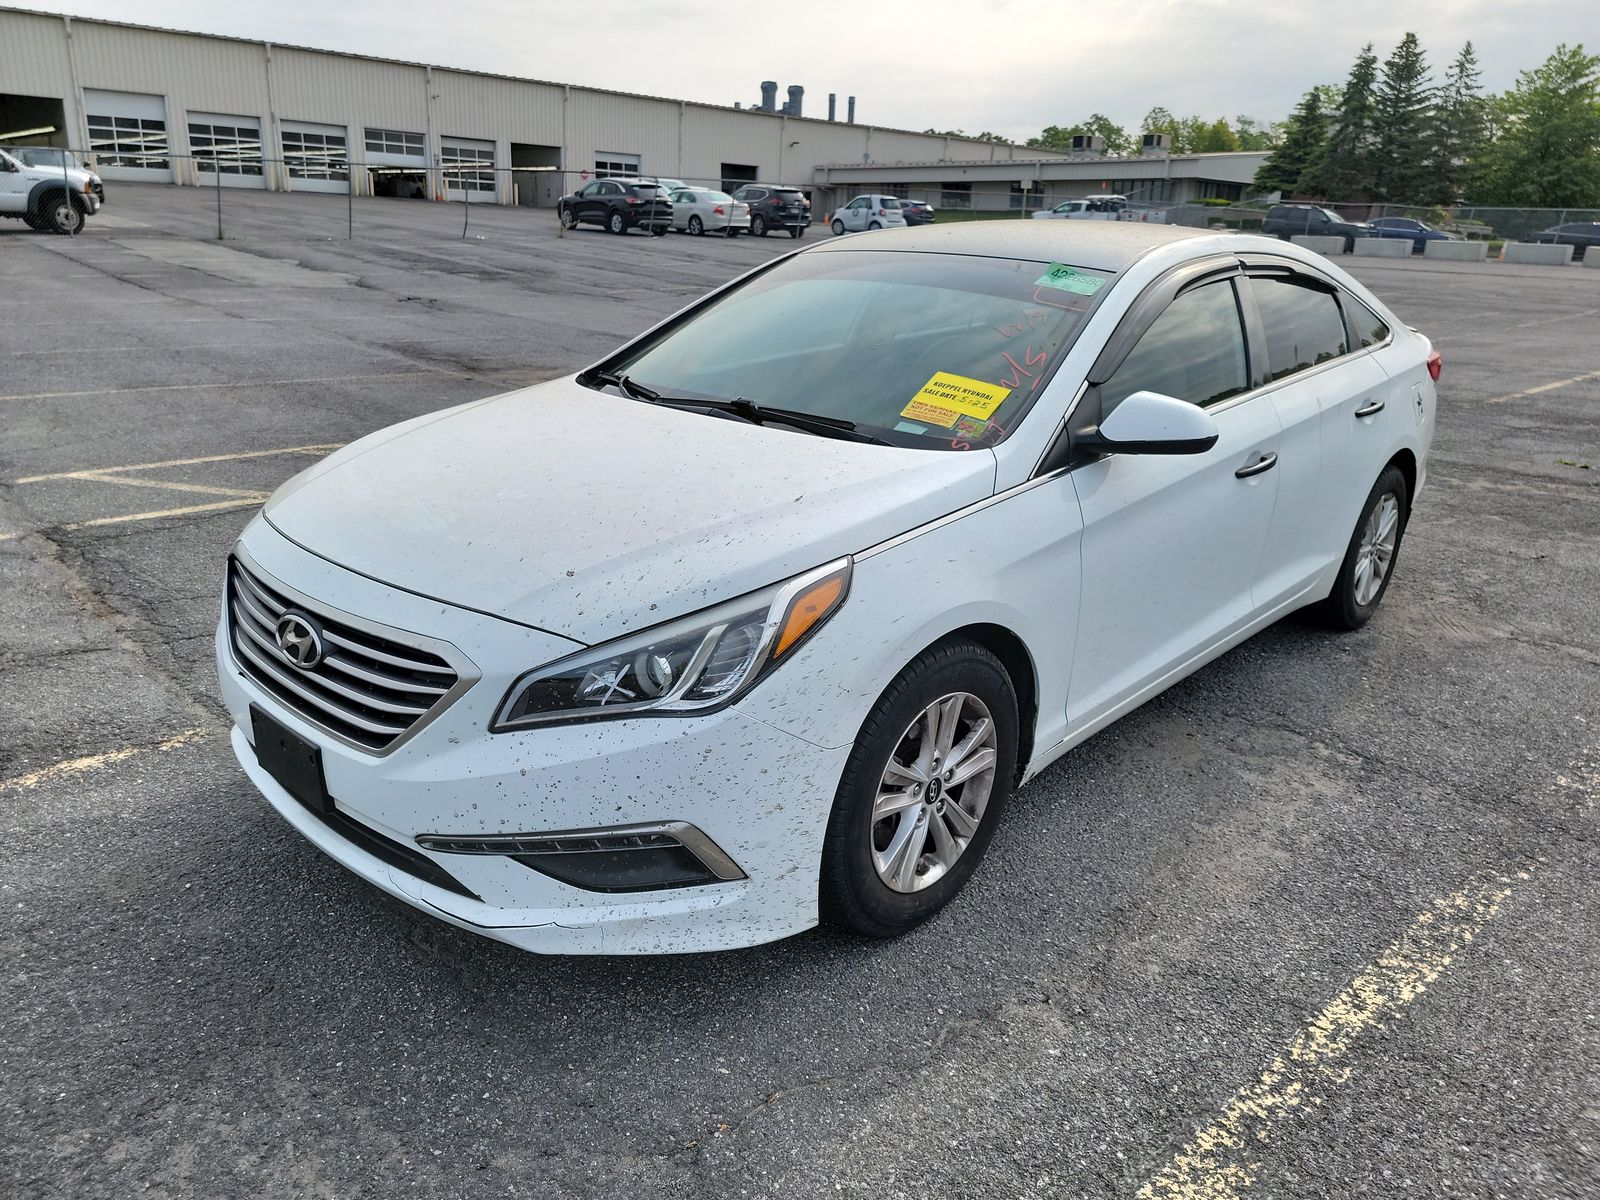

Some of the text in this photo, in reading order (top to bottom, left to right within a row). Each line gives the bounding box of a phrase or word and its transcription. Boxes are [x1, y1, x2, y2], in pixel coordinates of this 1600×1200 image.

[923, 388, 957, 400] SALE DATE
[933, 381, 993, 400] KOEPPEL HYUNDAI
[938, 410, 954, 418] SALE
